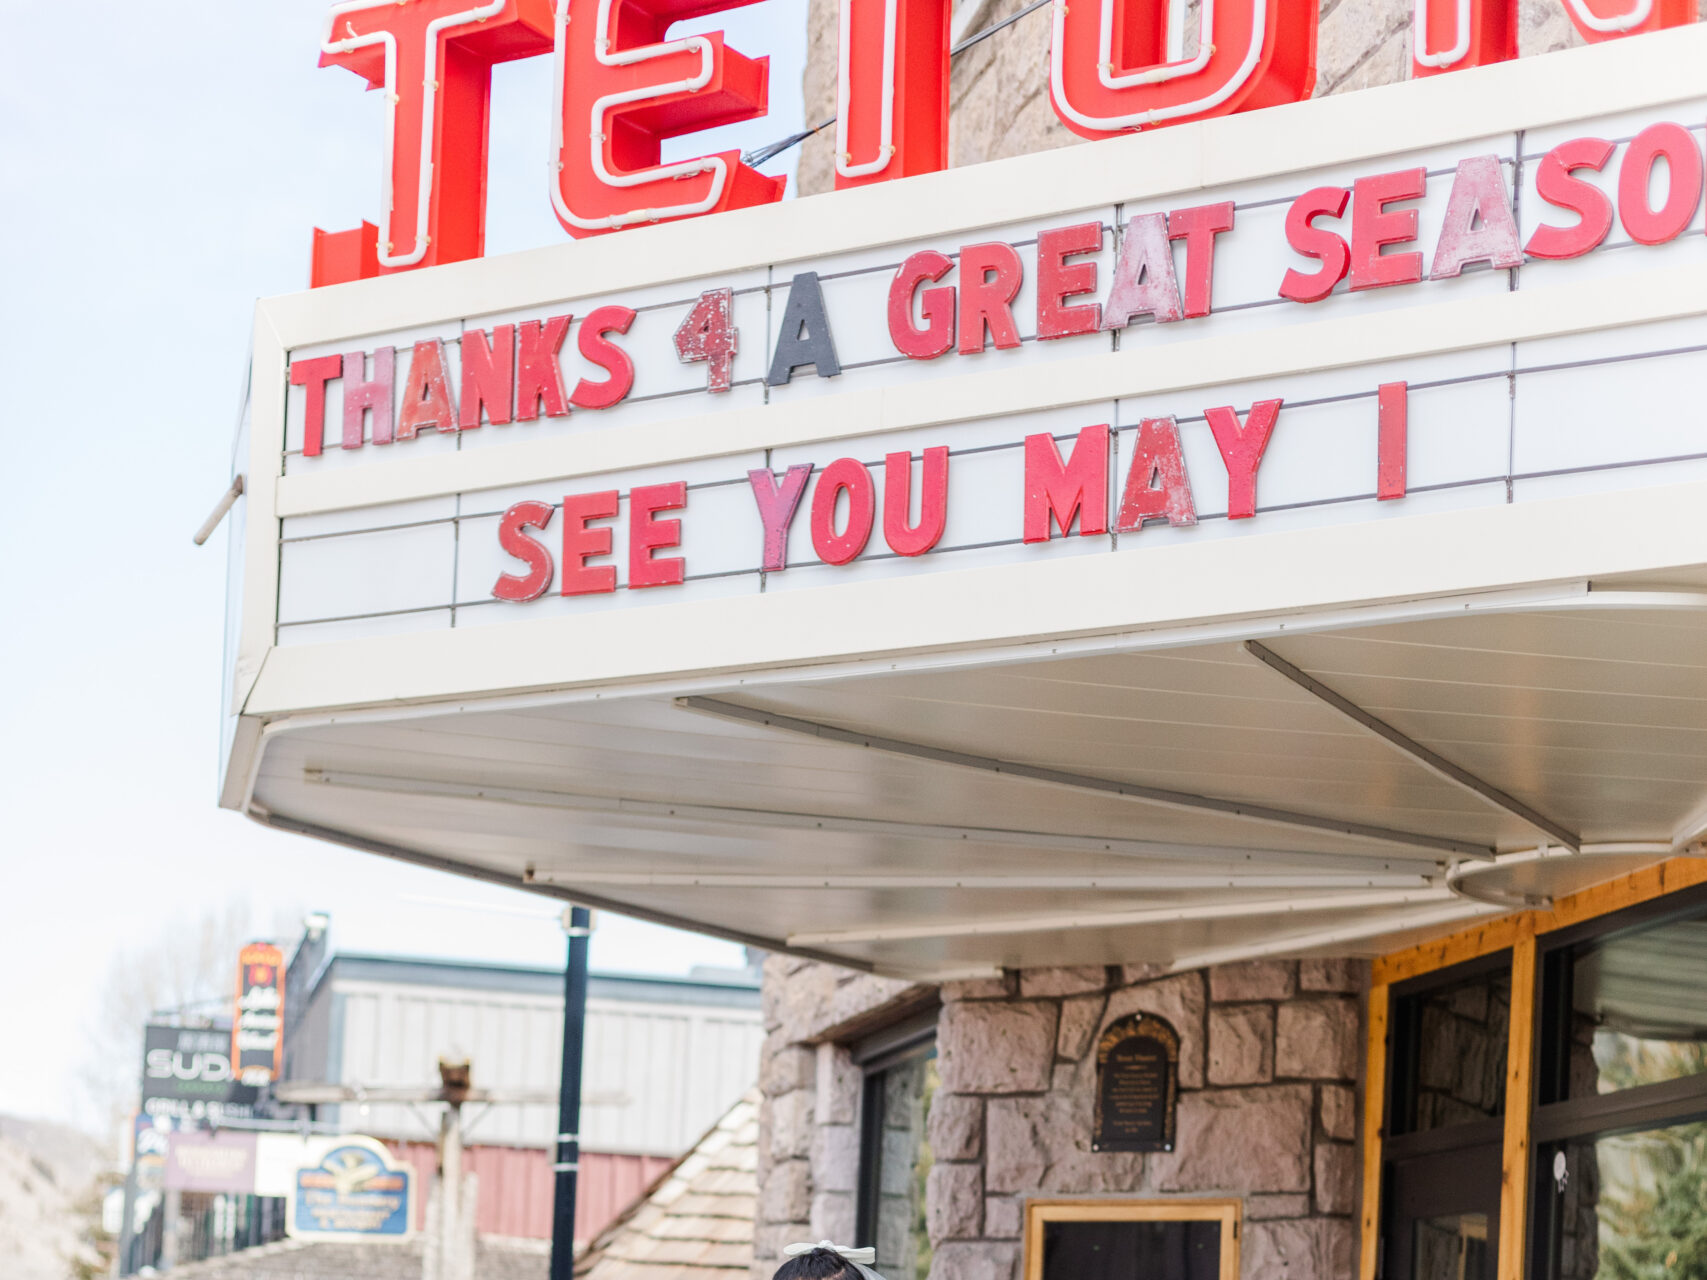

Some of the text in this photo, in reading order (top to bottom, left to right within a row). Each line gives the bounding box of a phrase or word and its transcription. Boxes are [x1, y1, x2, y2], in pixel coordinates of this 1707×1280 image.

[319, 0, 1700, 273] TET
[290, 120, 1707, 458] THANKS 4 A GREAT SEASO
[491, 480, 688, 603] SEE
[748, 445, 950, 572] YOU
[1023, 397, 1285, 545] MAY
[146, 1048, 236, 1082] SUD
